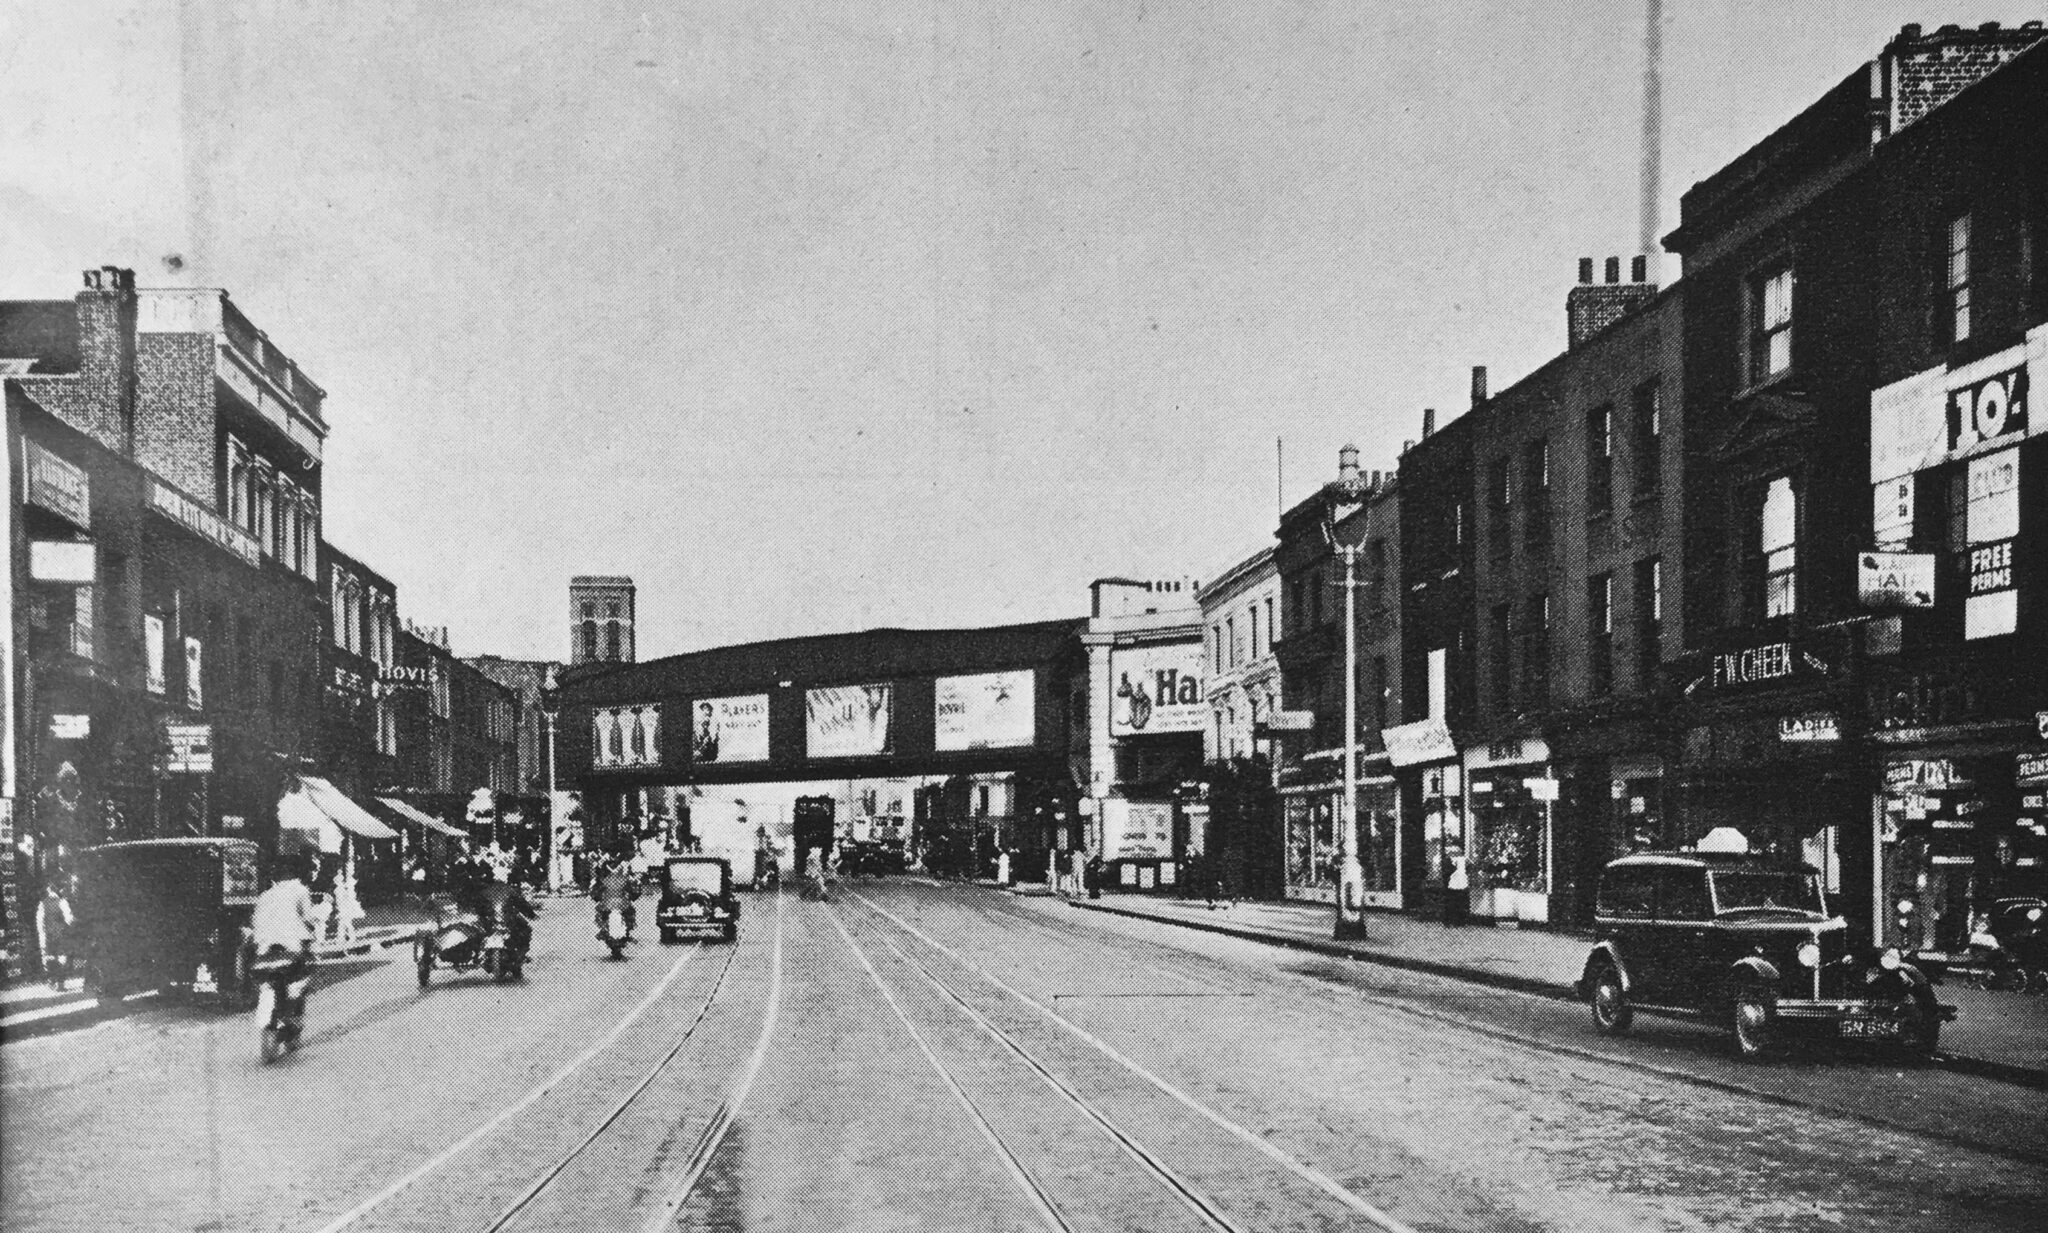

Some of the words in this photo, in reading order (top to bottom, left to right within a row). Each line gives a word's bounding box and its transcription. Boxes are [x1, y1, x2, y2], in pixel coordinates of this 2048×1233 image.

[1971, 542, 2012, 573] FREE
[1971, 568, 2012, 593] PERMS
[378, 664, 438, 683] HOVIS
[1741, 642, 1793, 683] CHEEK
